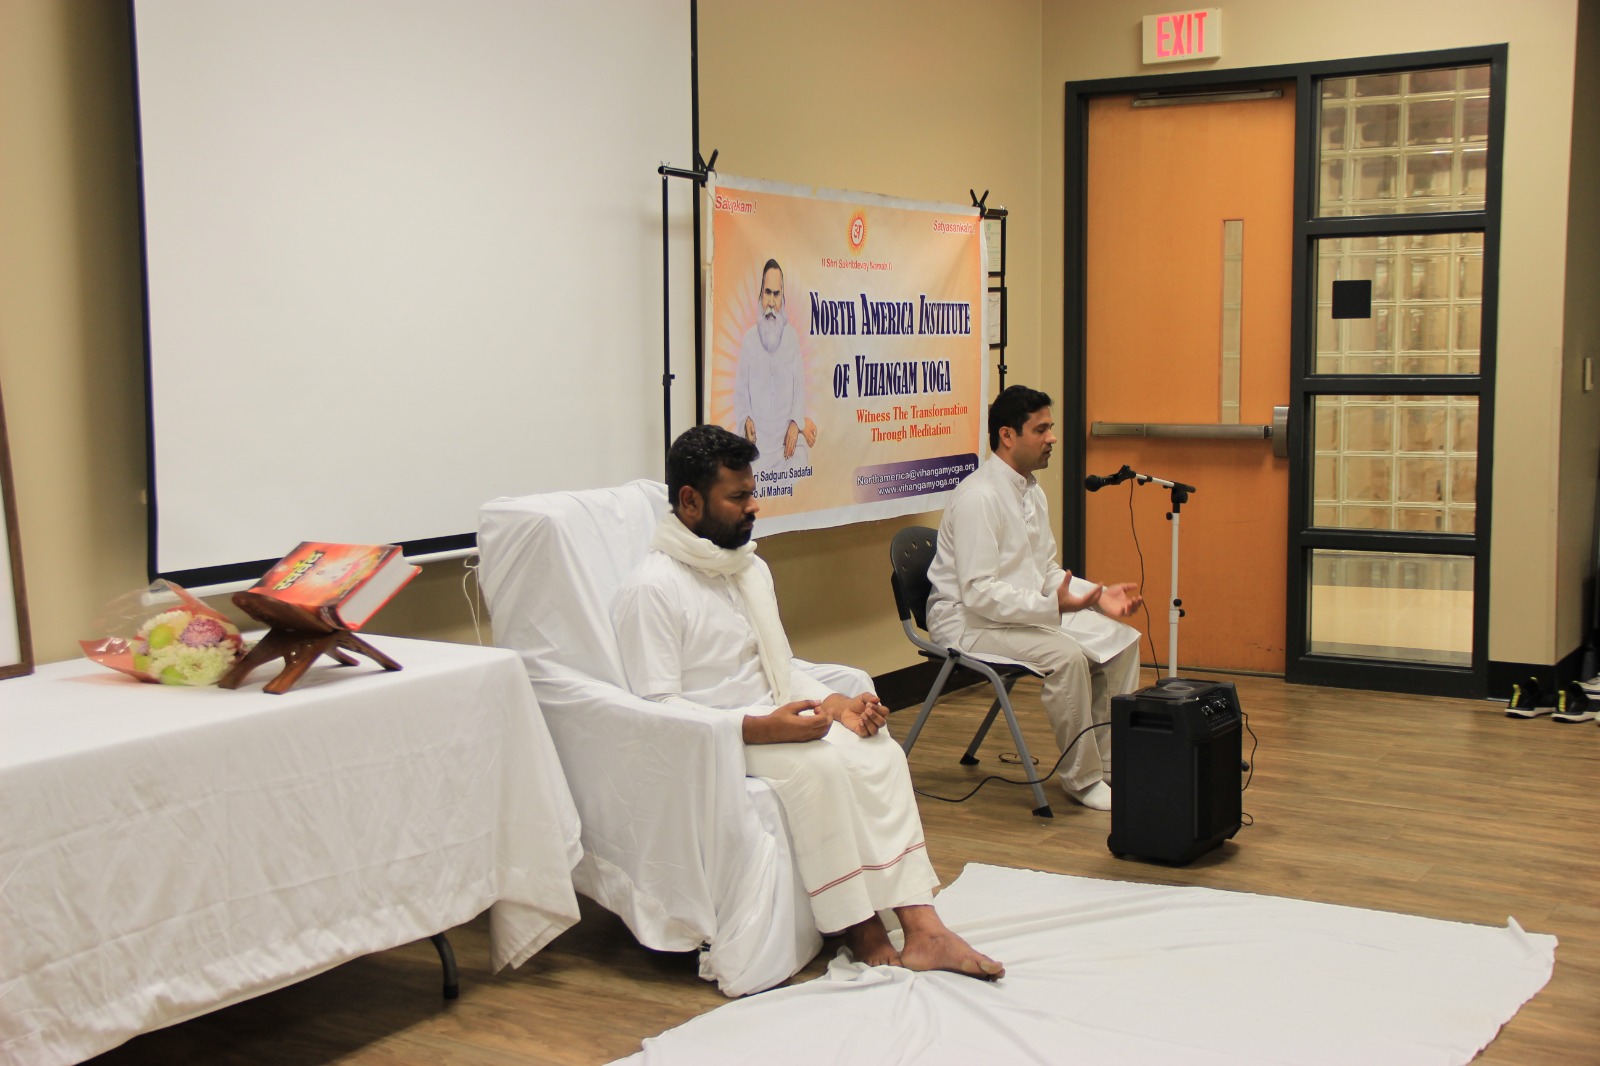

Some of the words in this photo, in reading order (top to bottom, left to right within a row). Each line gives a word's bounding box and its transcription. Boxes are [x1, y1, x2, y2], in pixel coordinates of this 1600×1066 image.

[1156, 11, 1208, 58] EXIT
[809, 291, 857, 336] NORTH
[860, 293, 914, 336] AMERICA
[918, 294, 971, 335] INSTITUTE
[855, 355, 918, 398] VIHANGAM
[921, 360, 951, 393] YOGA
[856, 409, 891, 423] Witness
[893, 406, 909, 421] The
[910, 403, 968, 419] Transformation
[871, 426, 907, 442] Through
[909, 423, 951, 439] Meditation
[760, 470, 788, 483] Sadguru
[789, 465, 813, 479] Sadafal
[856, 463, 975, 486] Northamerica@vihangamyoga.org
[759, 486, 766, 498] Ji
[767, 483, 793, 497] Maharaj
[878, 477, 960, 495] www.vihangamyoga.org
